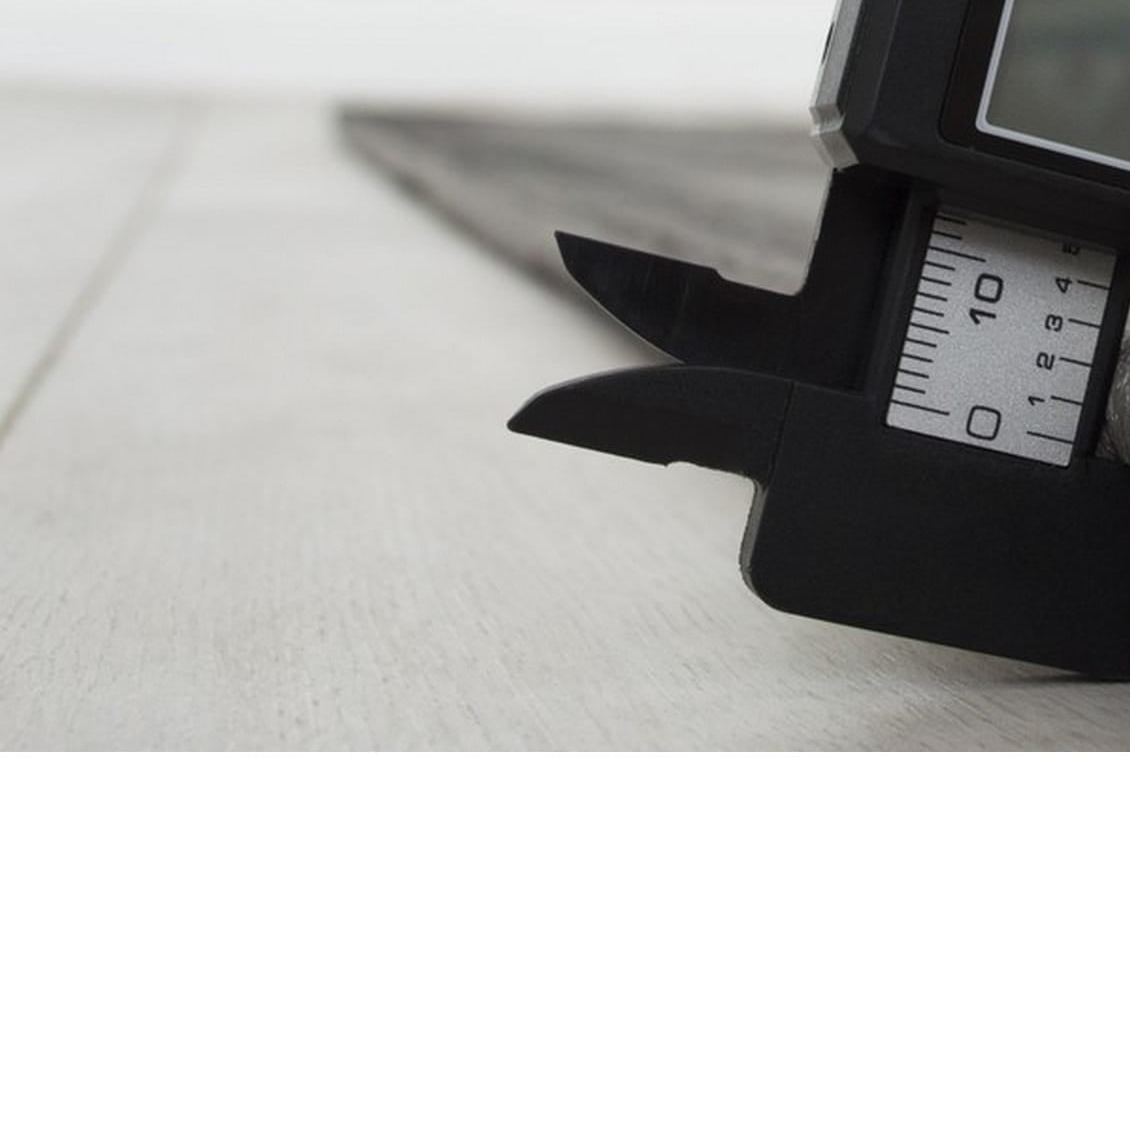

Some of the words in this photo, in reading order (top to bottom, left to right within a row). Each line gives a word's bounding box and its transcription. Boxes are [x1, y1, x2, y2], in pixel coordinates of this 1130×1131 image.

[1055, 277, 1072, 294] 4
[969, 273, 1003, 325] 10
[1045, 314, 1063, 331] 3
[1036, 352, 1055, 370] 2
[1028, 395, 1045, 406] 1
[966, 405, 1001, 441] 0
